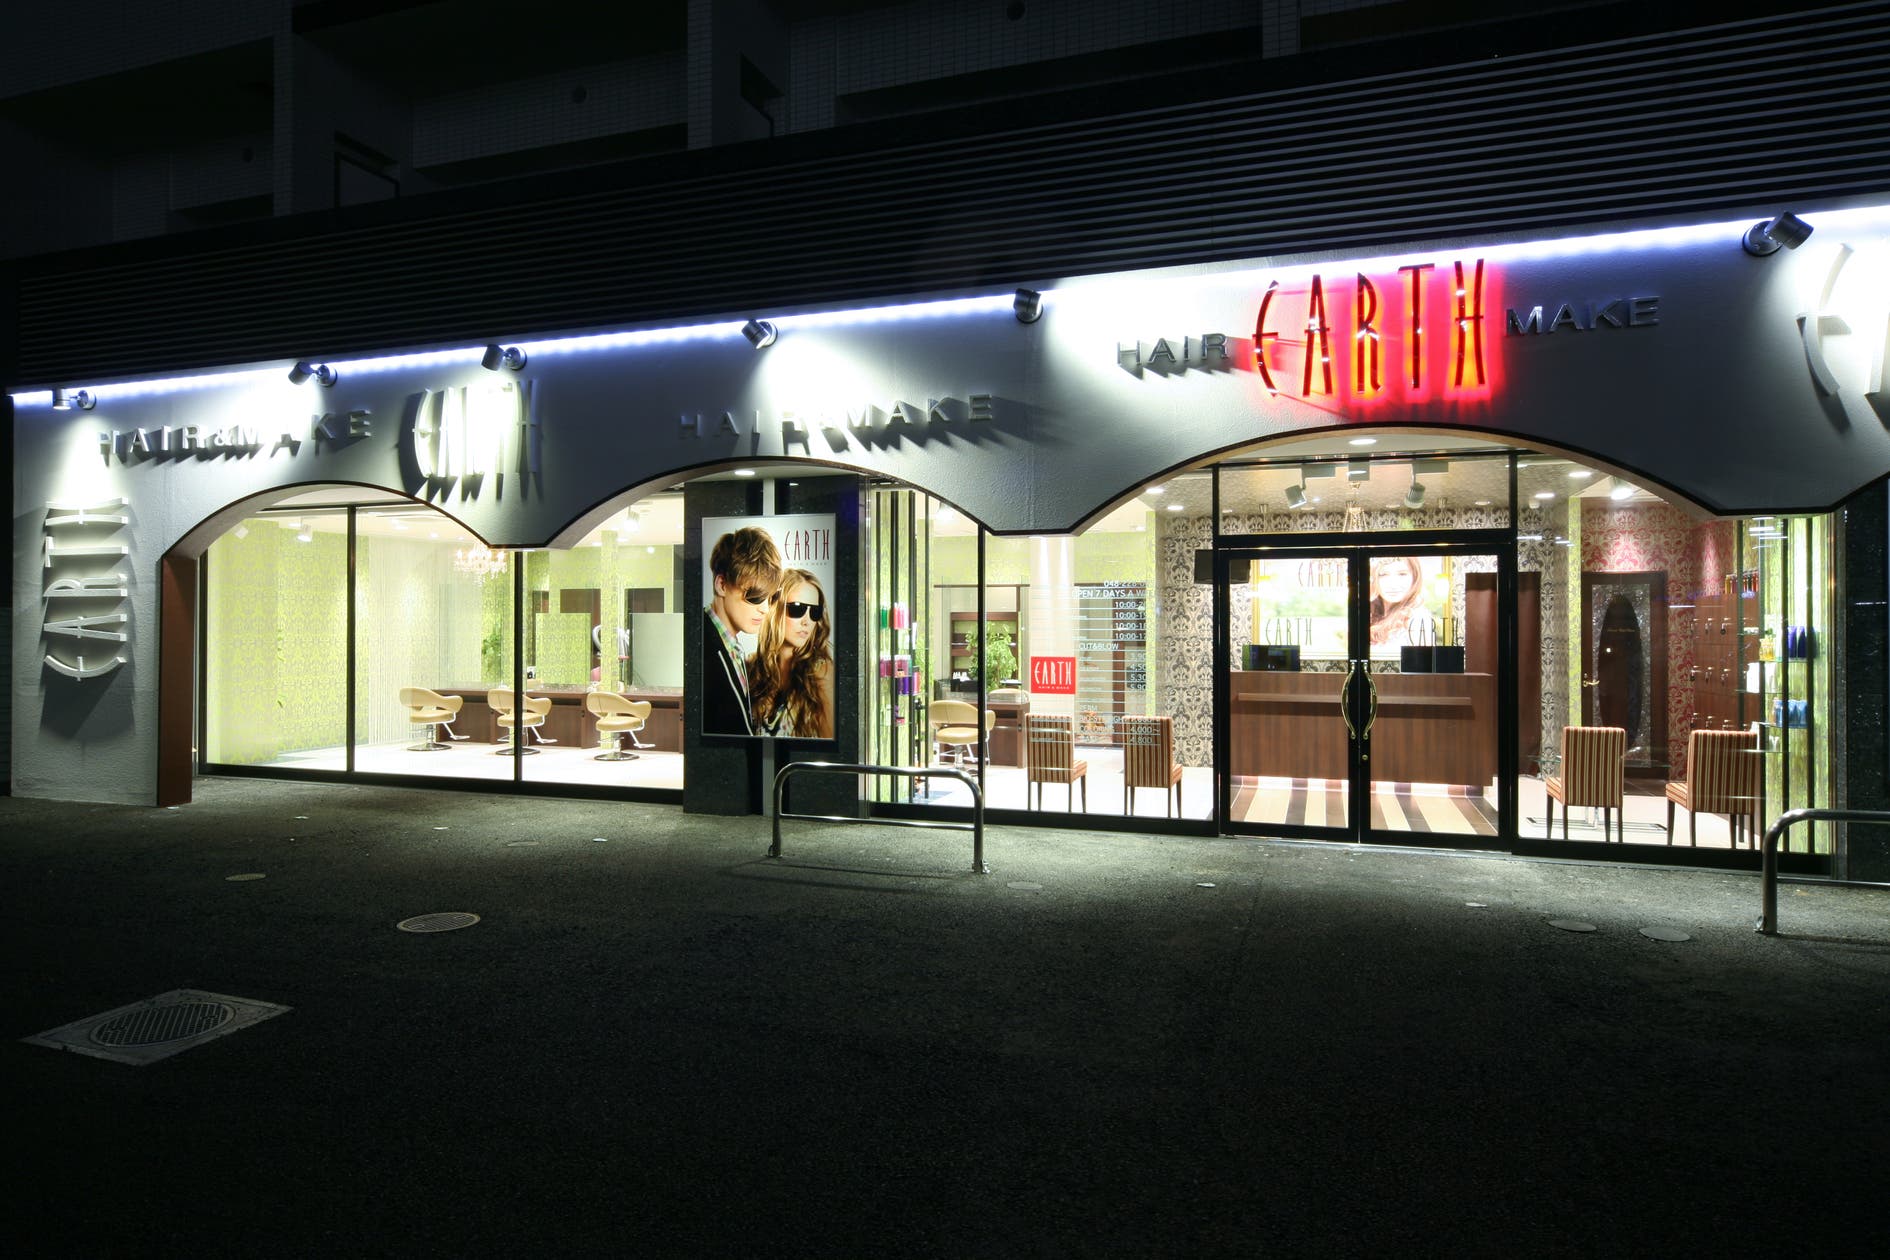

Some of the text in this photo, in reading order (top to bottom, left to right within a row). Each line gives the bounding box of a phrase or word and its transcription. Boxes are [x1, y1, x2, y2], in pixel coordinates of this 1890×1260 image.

[1117, 259, 1661, 397] HAIR EARTH MAKE
[784, 529, 830, 561] EARTH
[43, 497, 129, 682] EARTH
[1103, 589, 1126, 598] DAYS
[1265, 618, 1312, 646] EARTH
[1408, 618, 1459, 646] EARTH
[1034, 661, 1072, 685] EARTH
